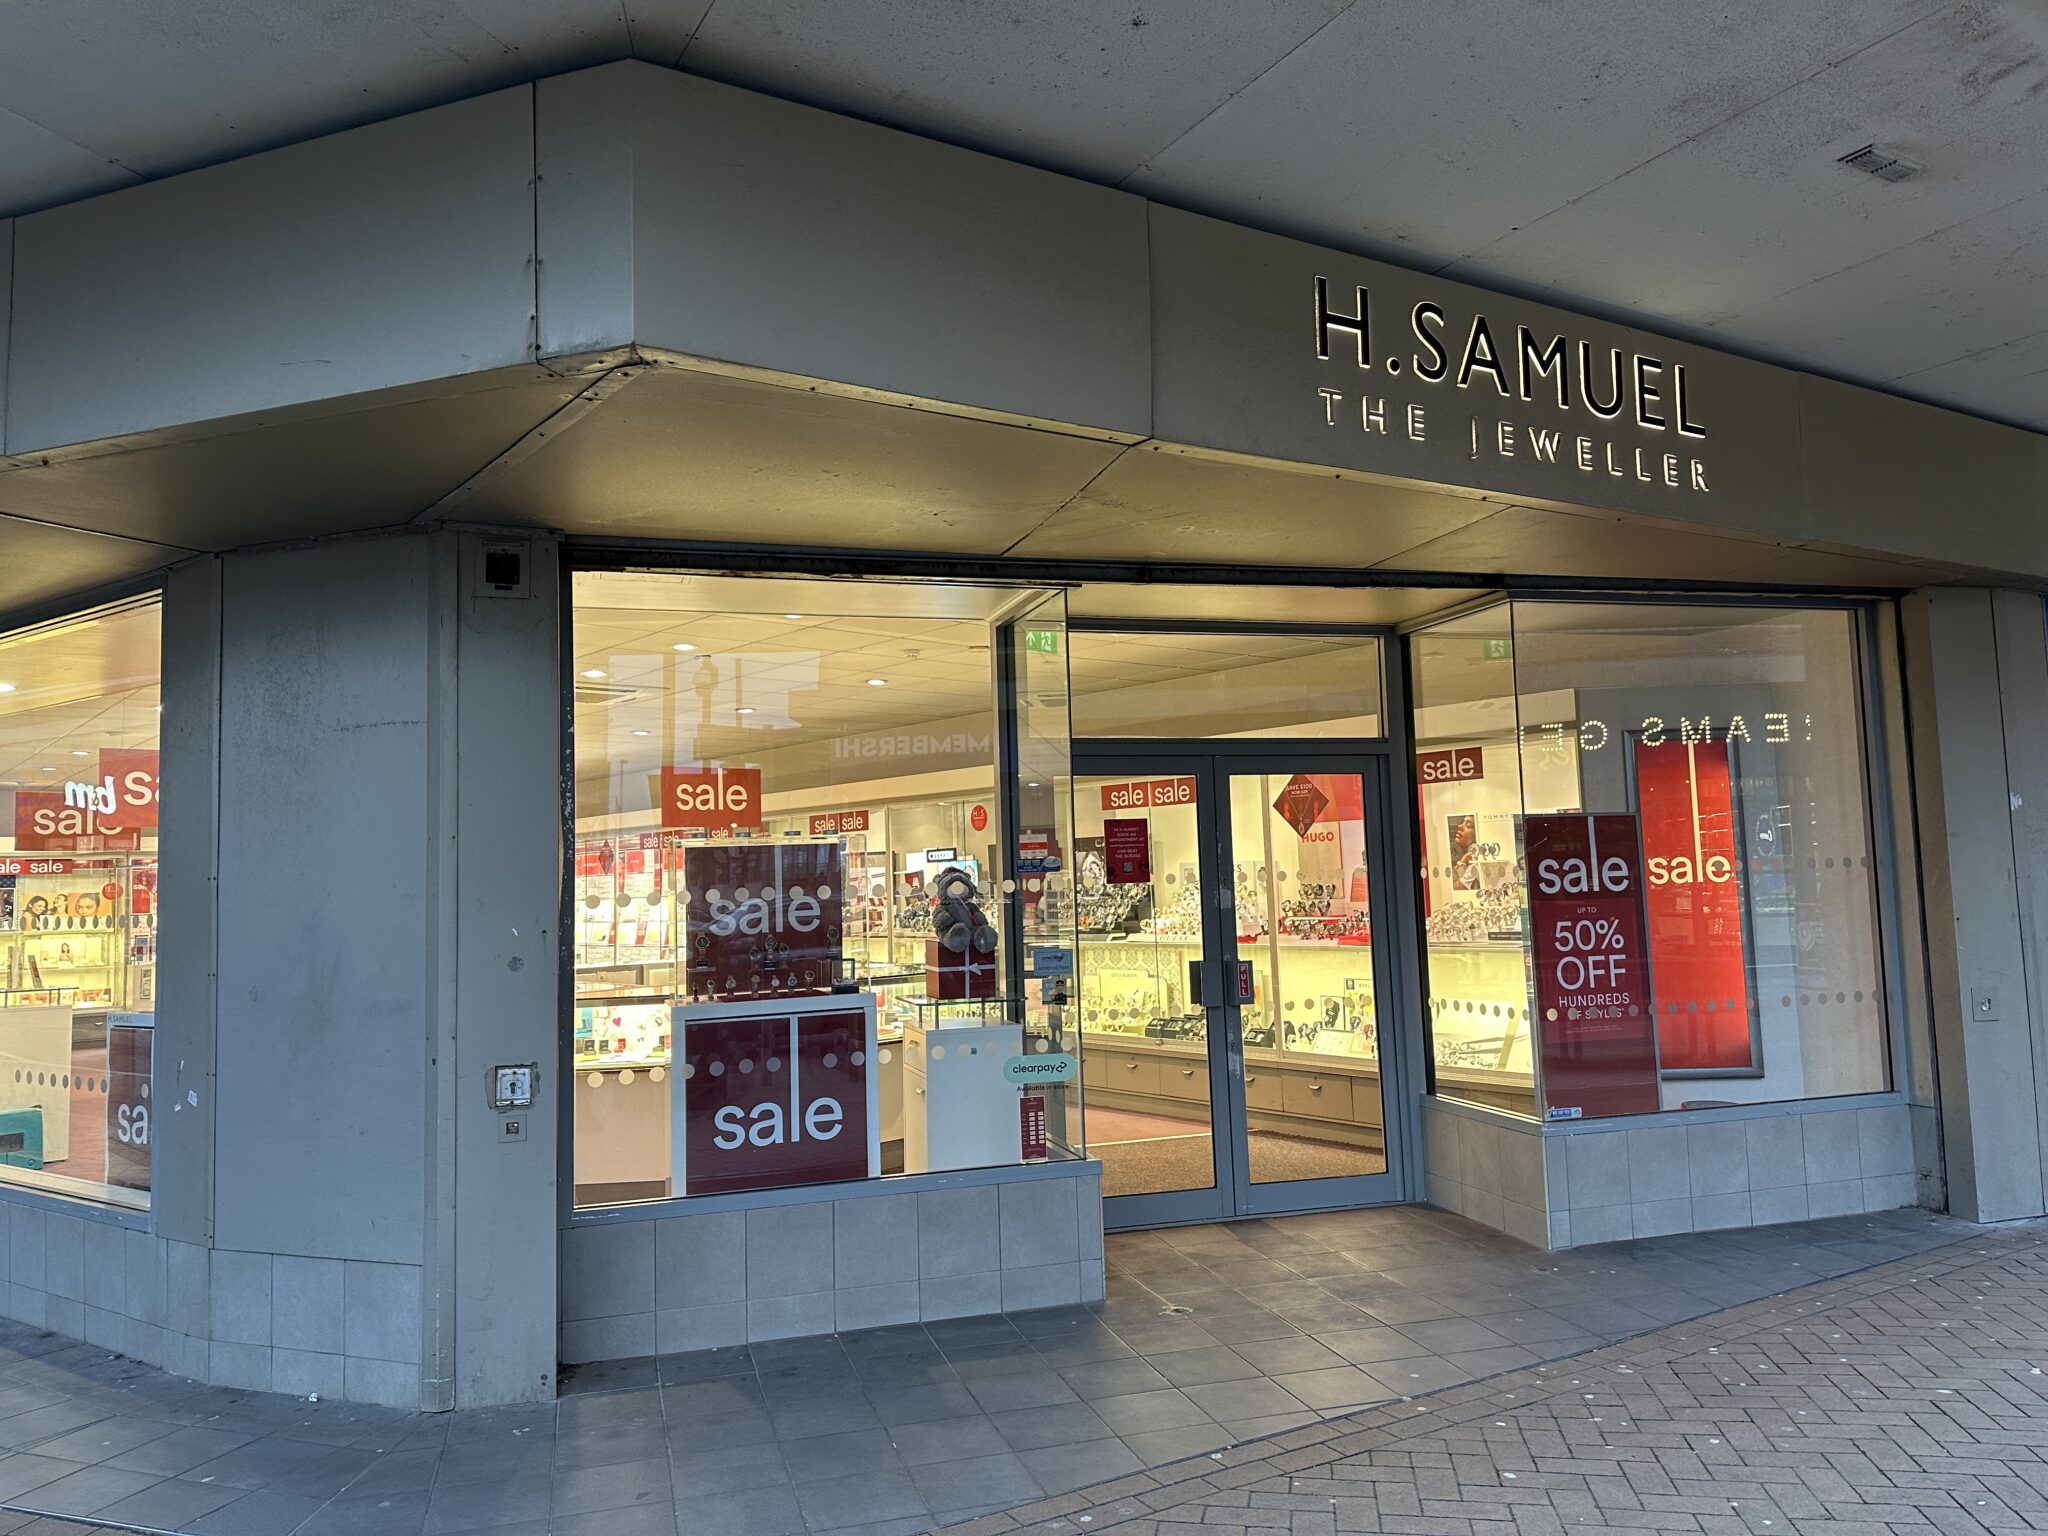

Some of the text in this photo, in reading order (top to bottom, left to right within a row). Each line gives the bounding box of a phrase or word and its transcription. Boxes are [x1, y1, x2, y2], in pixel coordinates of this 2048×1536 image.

[1314, 275, 1706, 438] H.SAMUEL
[1317, 387, 1710, 492] THE JEWELLER
[1423, 749, 1475, 781] sale
[676, 767, 748, 811] sale
[1111, 778, 1190, 807] sale sale
[814, 811, 864, 833] sale sale
[1302, 831, 1334, 843] HUGO
[643, 832, 659, 848] sale
[29, 860, 63, 874] sale
[1554, 918, 1625, 952] 50%
[1240, 965, 1248, 996] PULL
[1557, 954, 1626, 990] OFF
[1558, 992, 1630, 1008] HUNDREDS
[1012, 1063, 1056, 1075] clearpay
